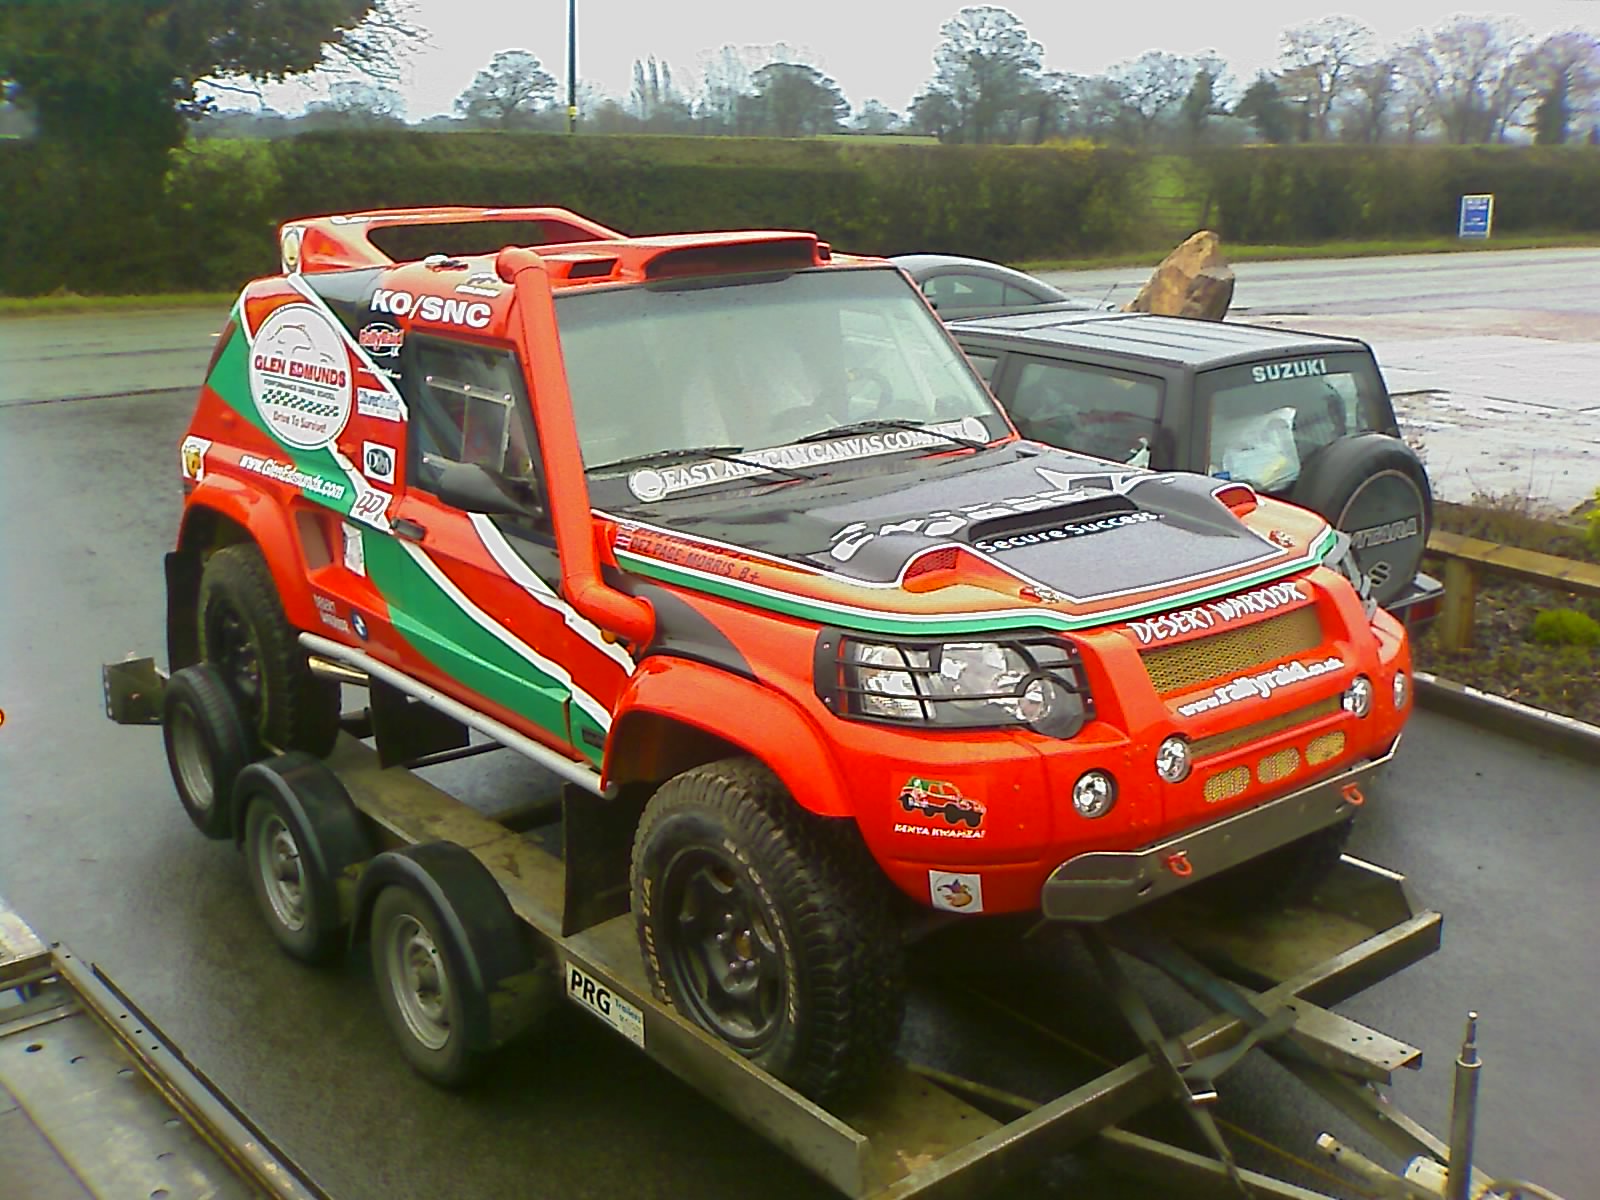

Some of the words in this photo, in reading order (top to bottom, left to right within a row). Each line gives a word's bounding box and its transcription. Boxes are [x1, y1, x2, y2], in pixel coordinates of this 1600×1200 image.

[370, 289, 491, 328] KO/SNC
[255, 354, 287, 374] GLEN
[289, 360, 347, 388] EDMUNDS
[1252, 358, 1327, 383] SUZUKI
[661, 462, 716, 487] EAST
[807, 435, 882, 461] CANVAS
[975, 528, 1068, 554] Secure
[1068, 511, 1159, 536] Success
[1126, 606, 1216, 645] DESERT
[1207, 582, 1307, 622] WARRIOR
[894, 823, 929, 836] KENYA
[571, 968, 611, 1016] PRG
